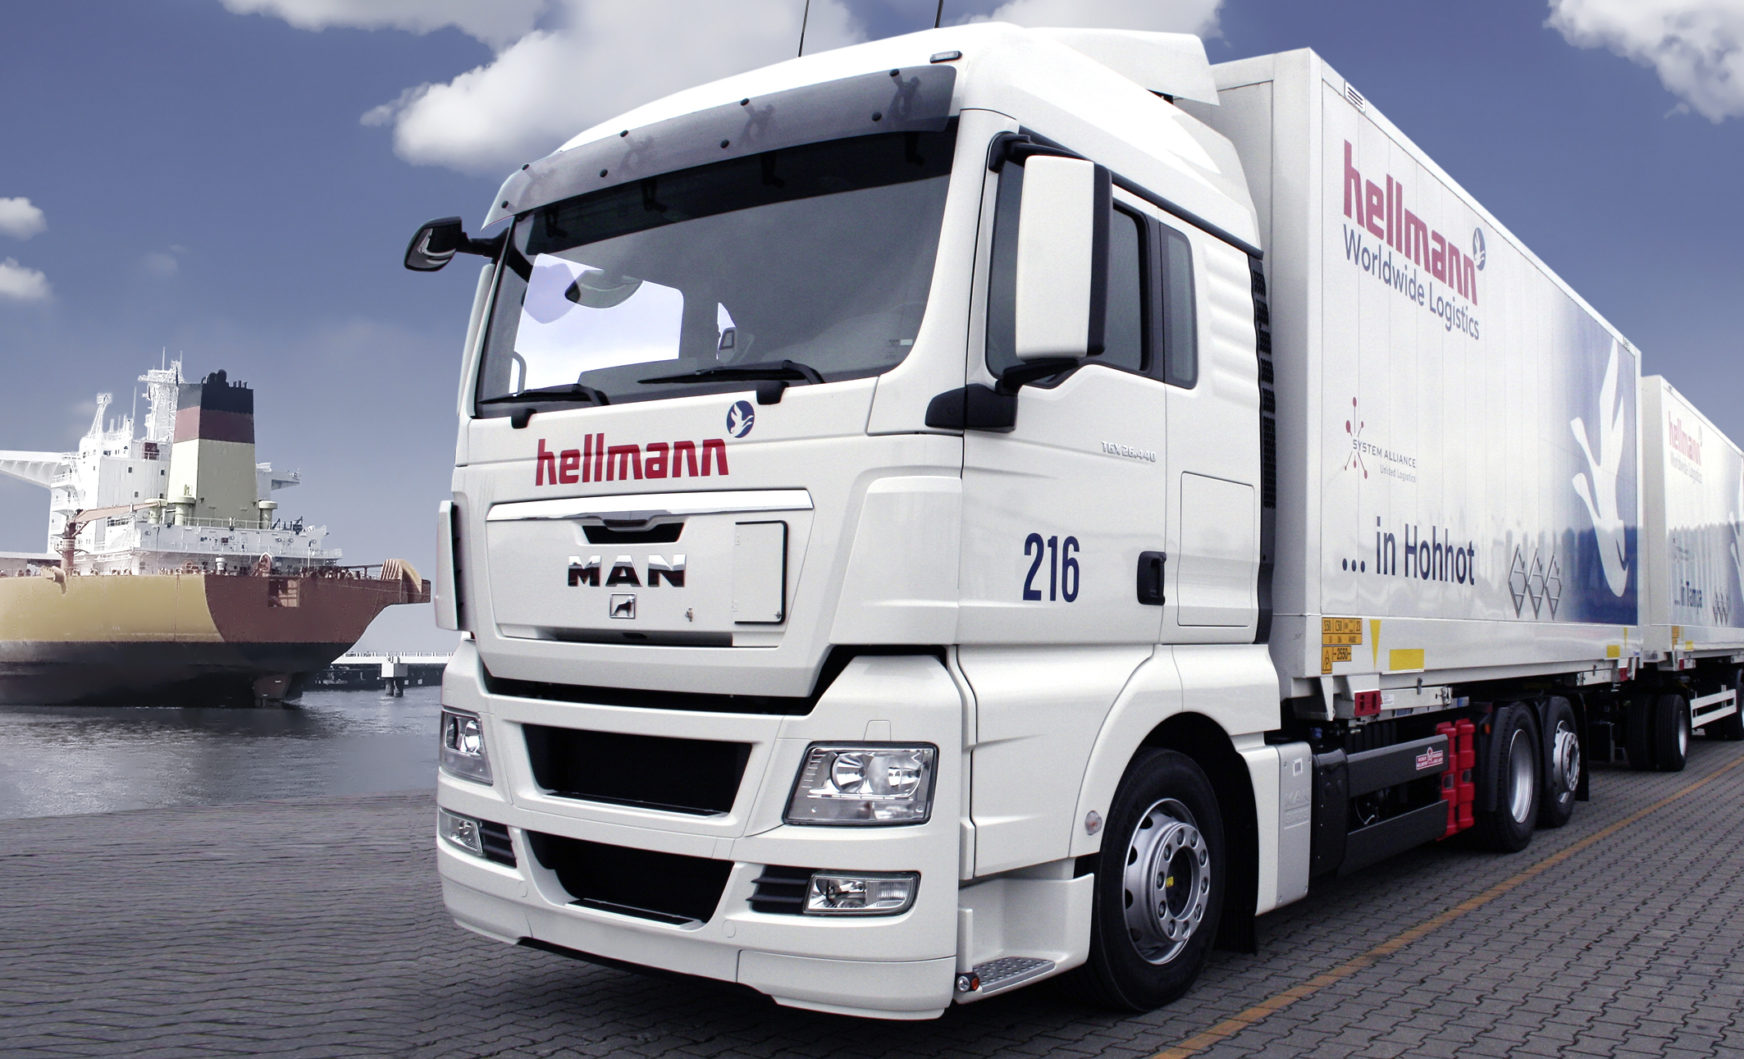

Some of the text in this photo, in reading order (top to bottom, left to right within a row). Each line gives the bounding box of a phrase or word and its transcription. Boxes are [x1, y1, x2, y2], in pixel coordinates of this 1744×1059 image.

[1344, 138, 1478, 306] hellmann
[1343, 223, 1480, 341] Worldwide Logistics
[535, 433, 730, 487] hellmann
[1352, 439, 1416, 469] SYSTEM ALLIANCE
[567, 554, 687, 588] MAN
[1022, 532, 1080, 603] 216
[1376, 516, 1396, 576] in
[1404, 523, 1475, 586] Hohhot
